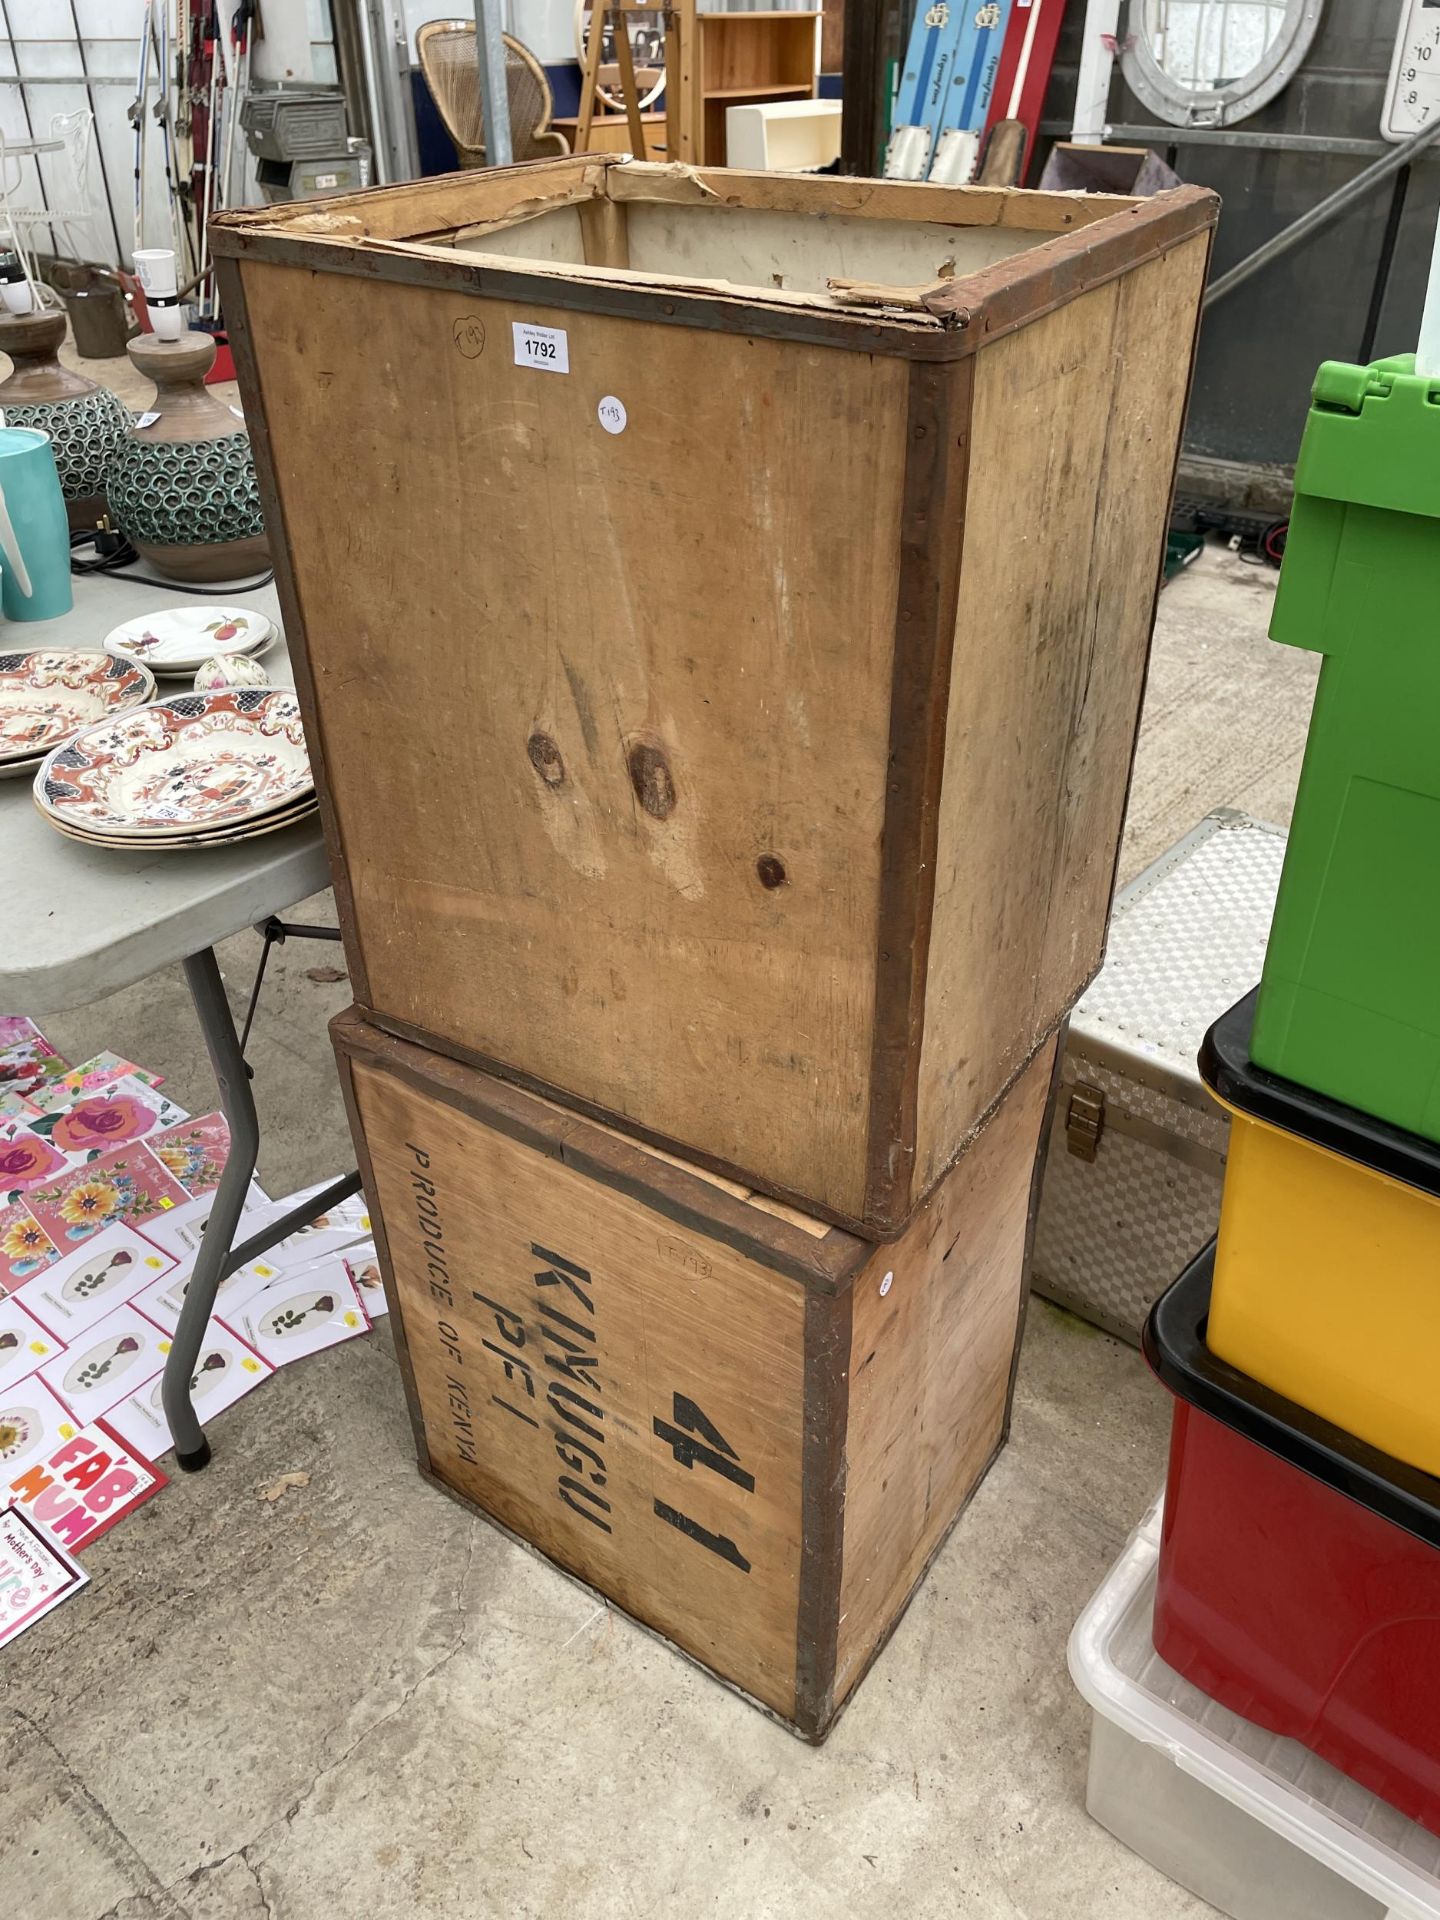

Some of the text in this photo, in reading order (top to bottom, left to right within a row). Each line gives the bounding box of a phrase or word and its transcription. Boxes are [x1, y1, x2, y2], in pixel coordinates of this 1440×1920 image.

[1418, 46, 1431, 60] 10
[1406, 67, 1416, 81] 9
[1408, 90, 1417, 104] 8
[1421, 106, 1430, 120] 7
[525, 339, 556, 359] 1792
[405, 1142, 478, 1466] PRODUCE OF KENYA
[48, 1436, 138, 1513] FAB
[9, 1464, 98, 1546] MUM
[4, 1533, 33, 1564] Mother's
